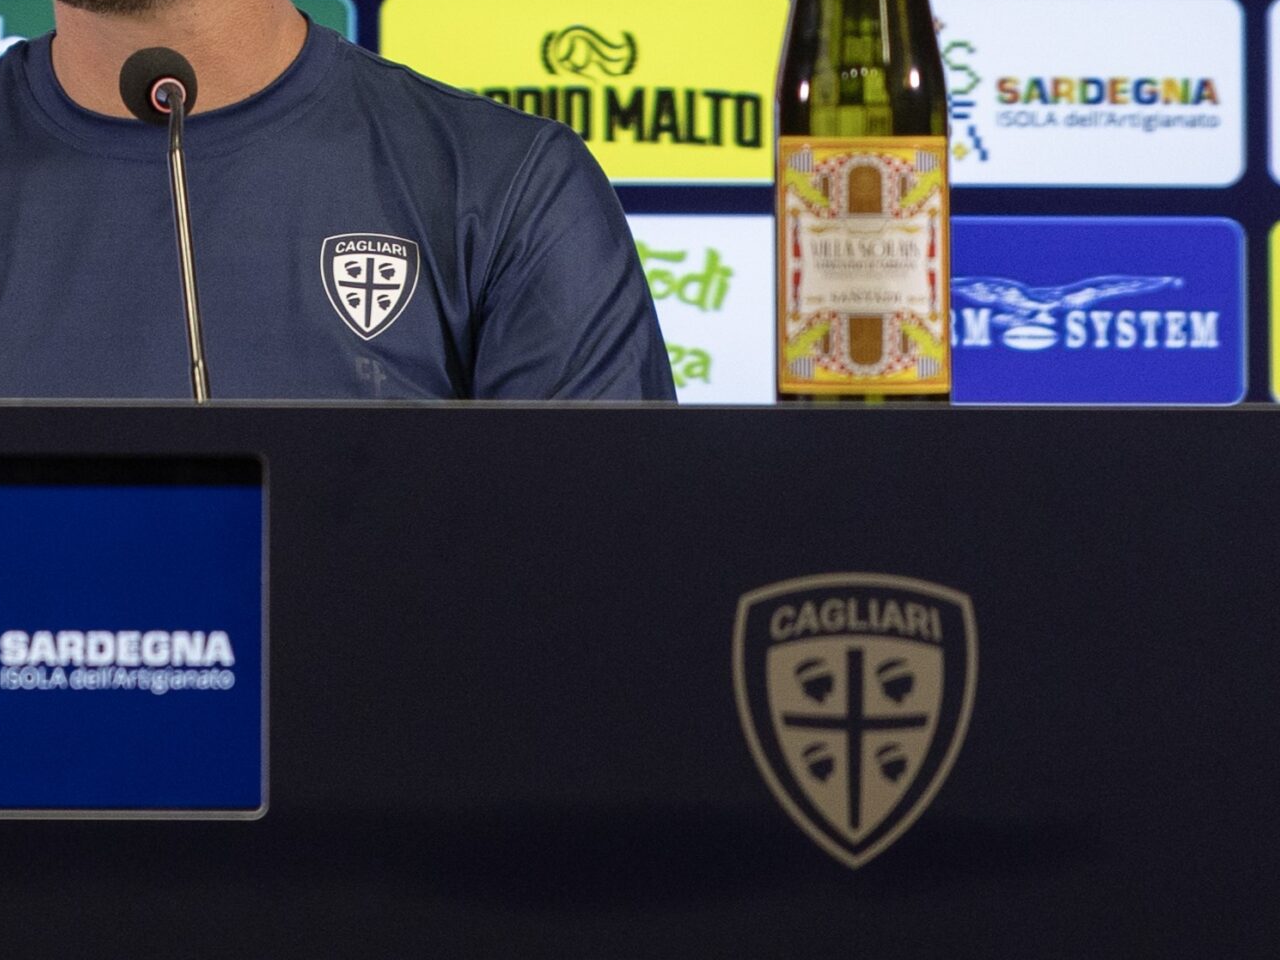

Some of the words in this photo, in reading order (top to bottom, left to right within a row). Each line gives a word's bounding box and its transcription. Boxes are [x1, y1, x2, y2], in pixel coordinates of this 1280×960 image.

[996, 77, 1220, 107] SARDEGNA
[604, 86, 763, 148] MALTO
[996, 110, 1057, 127] ISOLA
[1064, 109, 1221, 132] dell'Artigianato
[334, 240, 408, 257] CAGLIARI
[1065, 310, 1220, 349] SYSTEM
[768, 597, 943, 642] CAGLIARI
[0, 629, 236, 667] SARDEGNA
[0, 667, 67, 690] ISOLA
[70, 667, 236, 695] dell'Artigianato
